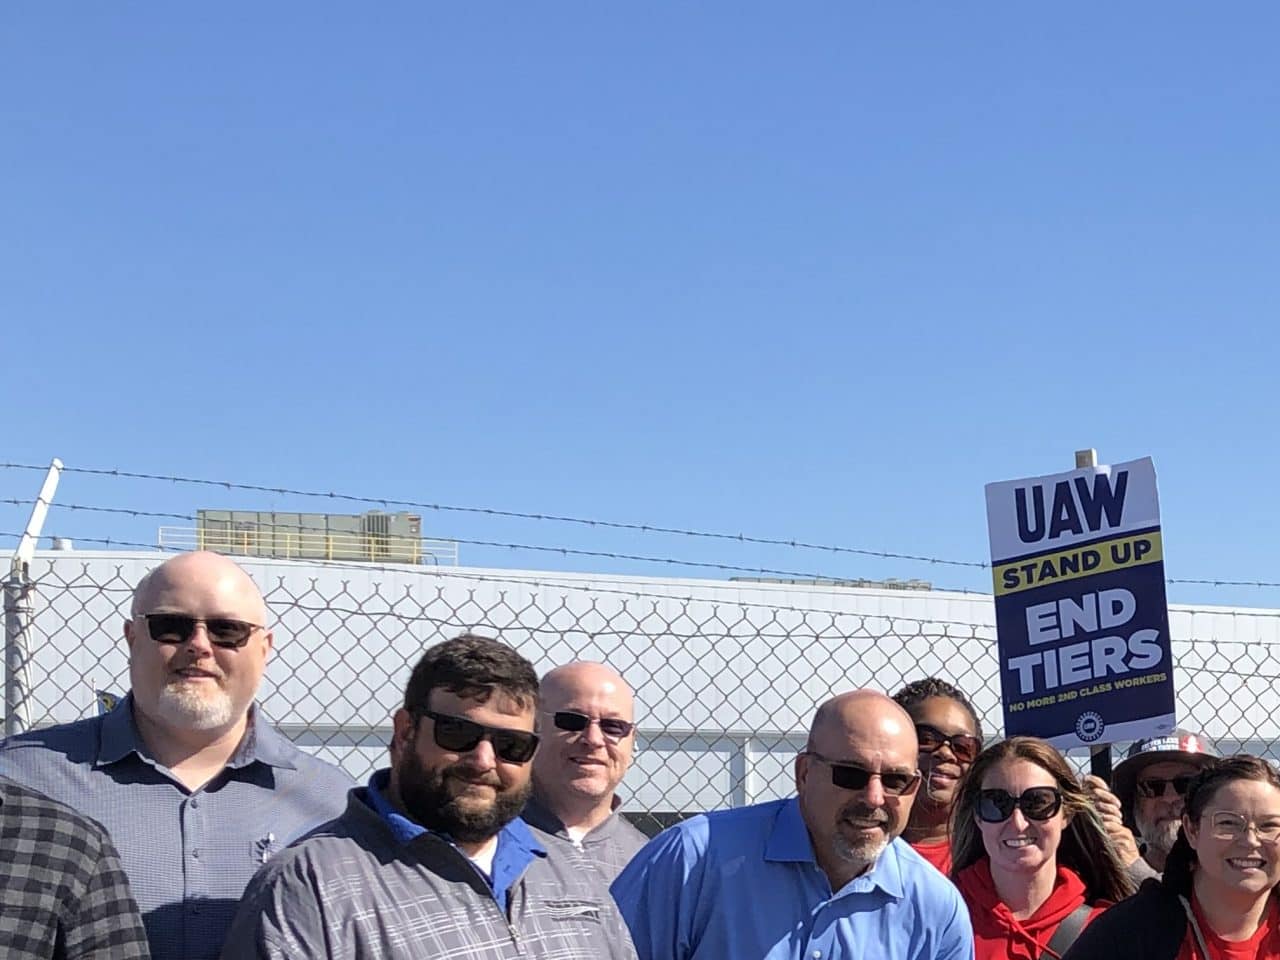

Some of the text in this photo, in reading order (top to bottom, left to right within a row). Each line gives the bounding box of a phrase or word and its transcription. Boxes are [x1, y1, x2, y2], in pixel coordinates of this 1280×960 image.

[1014, 470, 1129, 543] UAW
[1002, 539, 1152, 589] STAND UP
[1025, 588, 1137, 646] END
[1007, 629, 1163, 695] TIERS
[1009, 673, 1168, 712] NO MORE 2ND CLASS WORKERS
